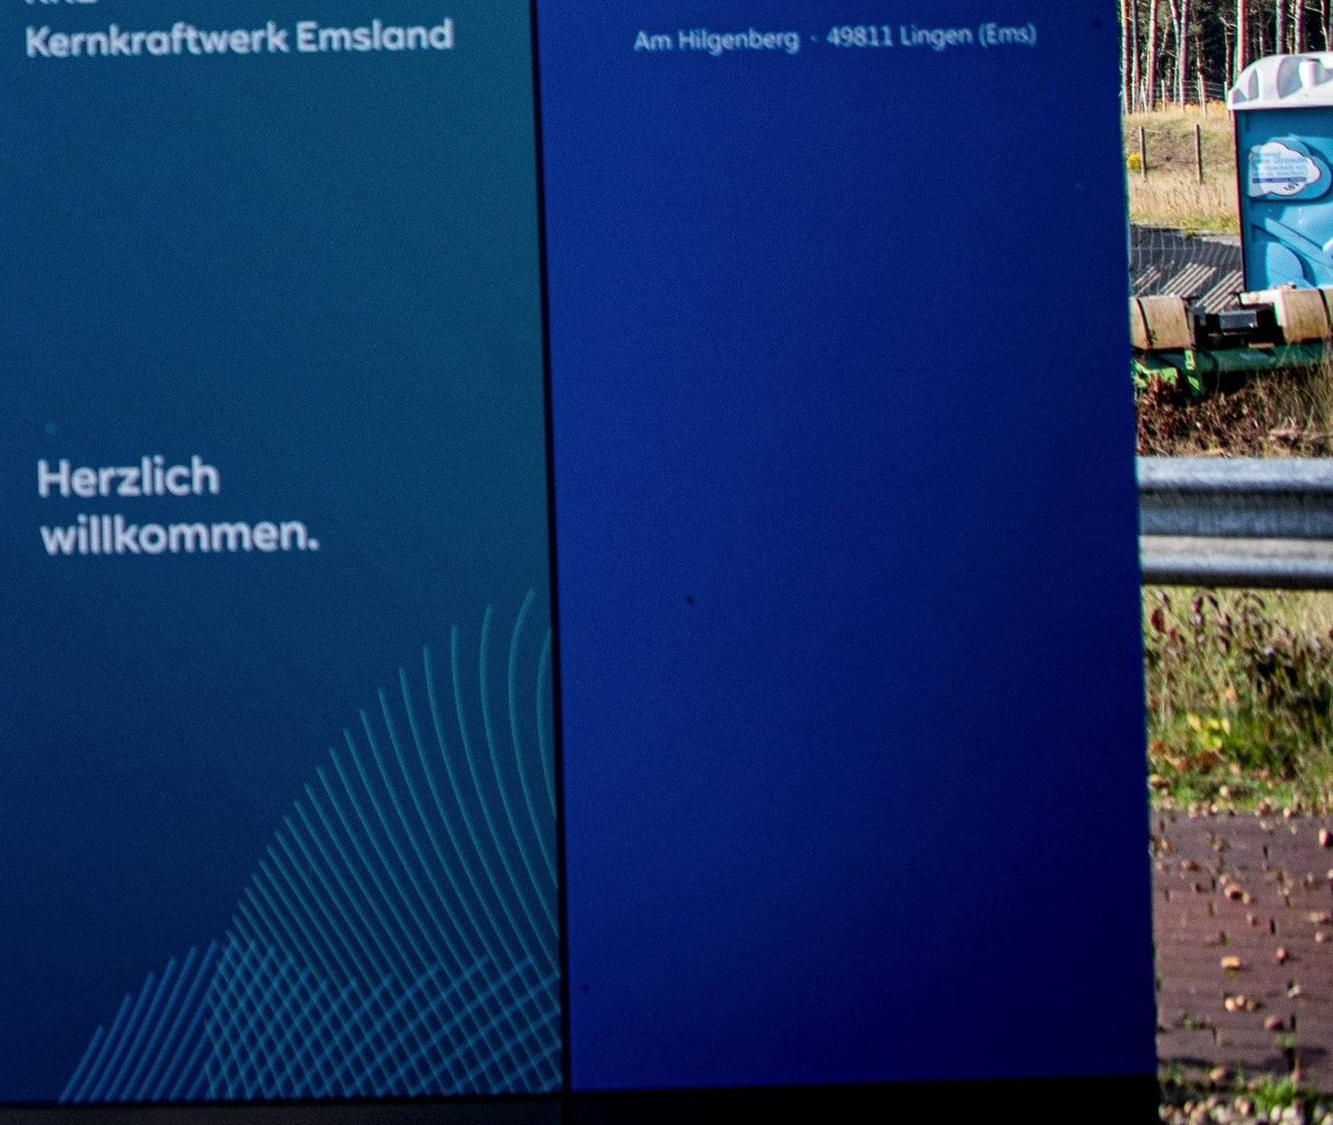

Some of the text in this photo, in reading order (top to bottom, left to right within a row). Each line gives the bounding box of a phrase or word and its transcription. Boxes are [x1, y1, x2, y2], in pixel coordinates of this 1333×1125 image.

[25, 18, 455, 58] Kernkraftwerk Emsland
[633, 30, 671, 52] Am
[678, 27, 799, 55] Hilgenberg
[826, 24, 893, 47] 49811
[899, 24, 973, 51] Lingen
[977, 21, 1038, 49] (Ems)
[37, 455, 220, 498] Herzlich
[40, 514, 320, 555] willkommen.
